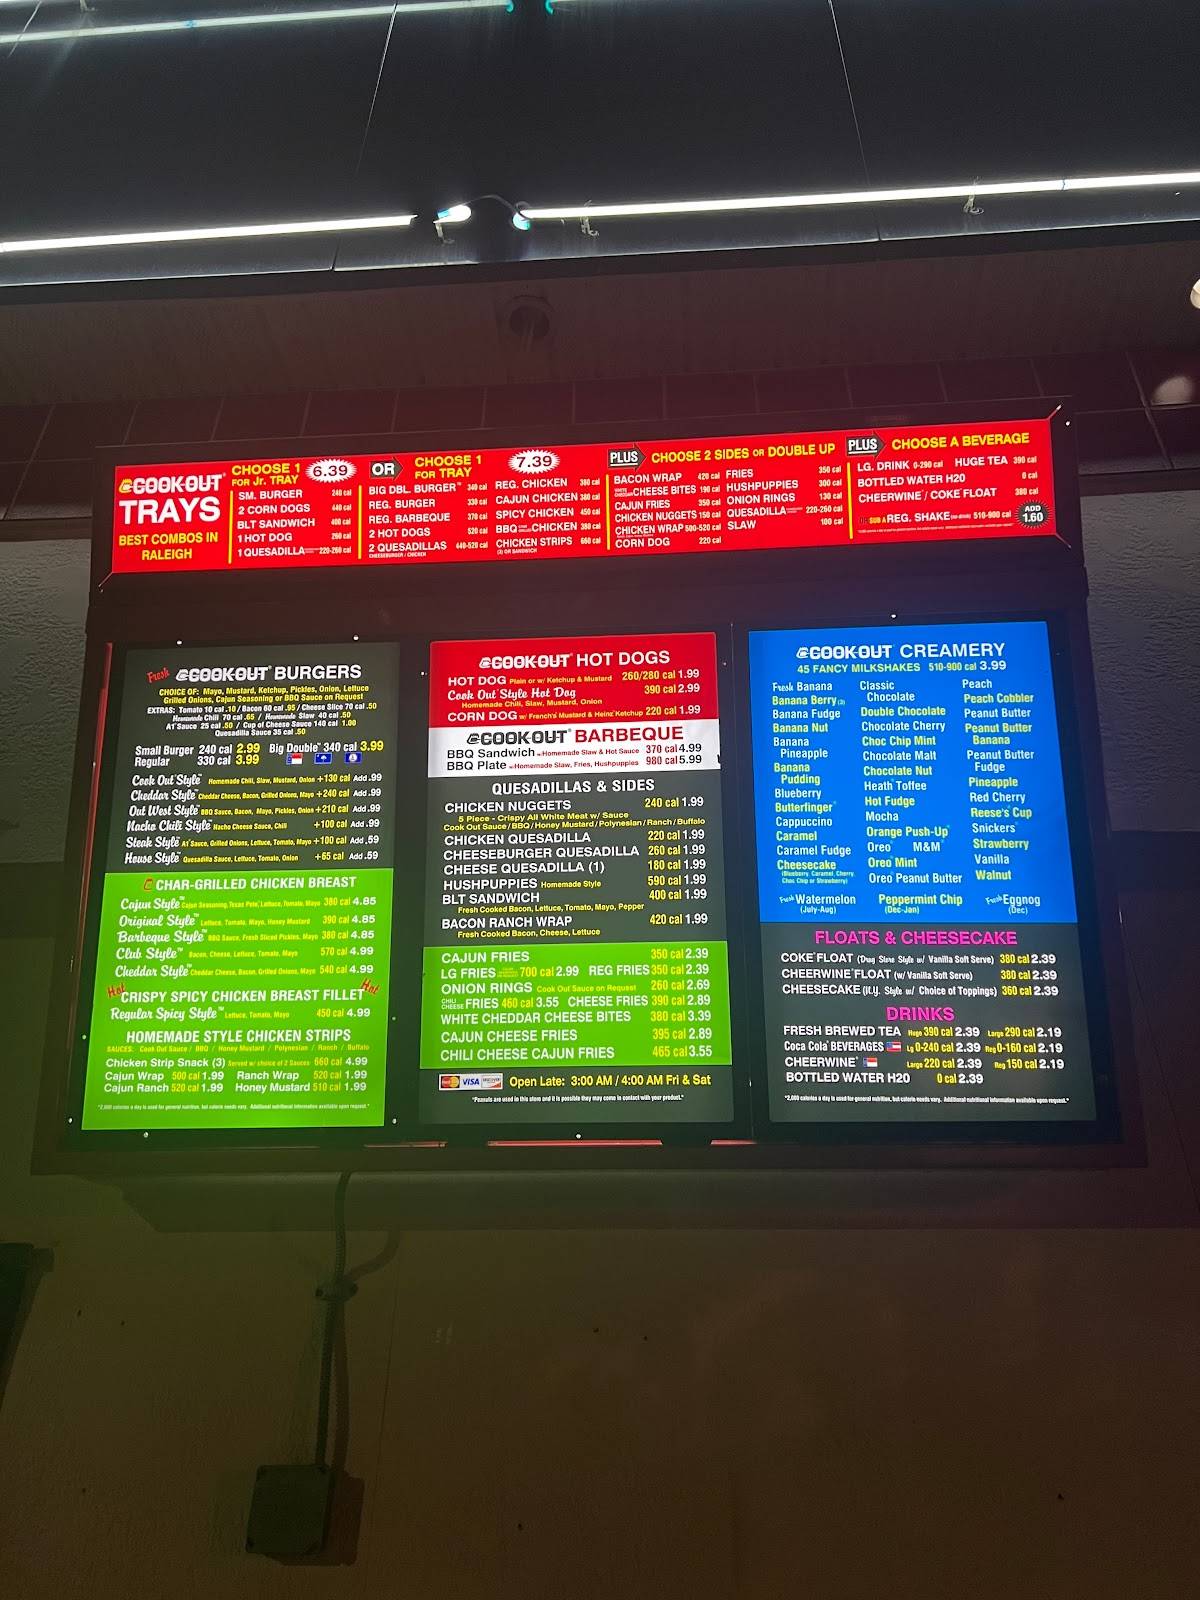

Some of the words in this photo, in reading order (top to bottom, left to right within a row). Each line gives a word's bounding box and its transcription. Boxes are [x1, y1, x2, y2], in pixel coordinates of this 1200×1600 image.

[848, 438, 877, 451] PLUS
[892, 436, 947, 450] CHOOSE
[950, 436, 959, 447] A
[962, 432, 1030, 446] BEVERAGE
[610, 451, 638, 463] PLUS
[651, 450, 701, 463] CHOOSE
[704, 450, 711, 461] 2
[714, 448, 749, 460] SIDES
[752, 448, 764, 457] OR
[768, 444, 816, 457] DOUBLE
[819, 443, 835, 454] UP
[415, 455, 471, 467] CHOOSE
[476, 454, 481, 464] 1
[516, 455, 552, 468] 7.39
[857, 462, 874, 472] LG.
[877, 460, 910, 471] DRINK
[232, 463, 289, 476] CHOOSE
[294, 463, 300, 473] 1
[313, 464, 348, 477] 6.39
[372, 463, 395, 476] OR
[415, 471, 436, 479] FOR
[439, 467, 472, 478] TRAY
[726, 468, 754, 479] FRIES
[818, 466, 831, 474] 350
[832, 465, 842, 473] cal
[232, 478, 250, 487] FOR
[252, 476, 266, 486] Jr.
[269, 474, 299, 485] TRAY
[238, 491, 257, 500] SM.
[259, 489, 303, 500] BURGER
[726, 495, 760, 505] ONION
[763, 492, 795, 503] RINGS
[119, 496, 221, 524] TRAYS
[238, 506, 245, 515] 2
[247, 505, 278, 515] CORN
[280, 503, 310, 513] DOGS
[496, 509, 526, 520] SPICY
[528, 507, 574, 518] CHICKEN
[1022, 512, 1044, 523] 1.60
[727, 520, 756, 530] SLAW
[119, 534, 149, 546] BEST
[151, 532, 203, 545] COMBOS
[206, 532, 218, 542] IN
[142, 548, 192, 561] RALEIGH
[900, 643, 1005, 658] CREAMERY
[577, 652, 613, 667] HOT
[619, 650, 670, 665] DOGS
[274, 664, 361, 680] BURGERS
[797, 664, 810, 674] 45
[813, 664, 848, 673] FANCY
[851, 662, 921, 673] MILKSHAKES
[928, 662, 962, 672] 510-900
[964, 662, 977, 671] cal
[979, 660, 1007, 670] 3.99
[147, 668, 170, 683] Fresh
[448, 676, 475, 686] HOT
[478, 675, 506, 686] DOG
[622, 670, 660, 681] 260/280
[662, 670, 676, 680] cal
[678, 668, 700, 679] 1.99
[962, 679, 992, 689] Peach
[860, 706, 895, 717] Double
[897, 706, 946, 716] Chocolate
[215, 729, 250, 737] Quesadilla
[575, 726, 684, 743] BARBEQUE
[135, 745, 162, 756] Small
[163, 745, 194, 757] Burger
[198, 744, 217, 754] 240
[218, 744, 233, 754] cal
[236, 743, 260, 754] 2.99
[134, 756, 170, 769] Regular
[197, 755, 215, 766] 330
[217, 755, 231, 766] cal
[235, 754, 259, 765] 3.99
[447, 761, 473, 771] BBQ
[477, 760, 507, 770] Plate
[492, 780, 591, 796] QUESADILLAS
[596, 780, 607, 792] &
[612, 779, 655, 792] SIDES
[774, 788, 822, 800] Blueberry
[445, 802, 504, 813] CHICKEN
[508, 800, 571, 811] NUGGETS
[645, 798, 662, 808] 240
[665, 797, 679, 807] cal
[681, 796, 704, 807] 1.99
[973, 838, 1029, 850] Strawberry
[974, 854, 1010, 864] Vanilla
[156, 878, 247, 891] CHAR-GRILLED
[250, 877, 304, 889] CHICKEN
[308, 876, 357, 888] BREAST
[480, 930, 510, 938] Cooked
[539, 929, 571, 937] Cheese,
[815, 930, 880, 944] FLOATS
[884, 931, 897, 945] &
[901, 931, 1017, 945] CHEESECAKE
[107, 983, 126, 998] Hot
[361, 978, 380, 995] Hot
[119, 991, 167, 1003] CRISPY
[170, 991, 208, 1003] SPICY
[211, 990, 266, 1002] CHICKEN
[270, 989, 320, 1001] BREAST
[323, 988, 364, 1001] FILLET
[441, 1013, 478, 1025] WHITE
[482, 1012, 541, 1024] CHEDDAR
[544, 1011, 593, 1023] CHEESE
[596, 1011, 631, 1022] BITES
[650, 1010, 669, 1022] 380
[671, 1010, 686, 1022] cal
[687, 1010, 711, 1022] 3.39
[886, 1007, 955, 1021] DRINKS
[126, 1030, 200, 1043] HOMEMADE
[203, 1030, 243, 1043] STYLE
[246, 1029, 301, 1042] CHICKEN
[305, 1029, 351, 1042] STRIPS
[784, 1025, 822, 1035] FRESH
[825, 1025, 875, 1036] BREWED
[878, 1026, 901, 1036] TEA
[105, 1071, 135, 1083] Cajun
[137, 1071, 165, 1082] Wrap
[172, 1071, 187, 1080] 500
[187, 1071, 200, 1080] cal
[202, 1071, 224, 1080] 1.99
[462, 1078, 480, 1086] VISA
[509, 1076, 537, 1089] Open
[540, 1076, 565, 1086] Late:
[571, 1075, 593, 1086] 3:00
[595, 1075, 613, 1086] AM
[621, 1074, 644, 1085] 4:00
[646, 1074, 663, 1085] AM
[666, 1074, 679, 1085] Fri
[682, 1074, 690, 1085] &
[693, 1074, 711, 1085] Sat
